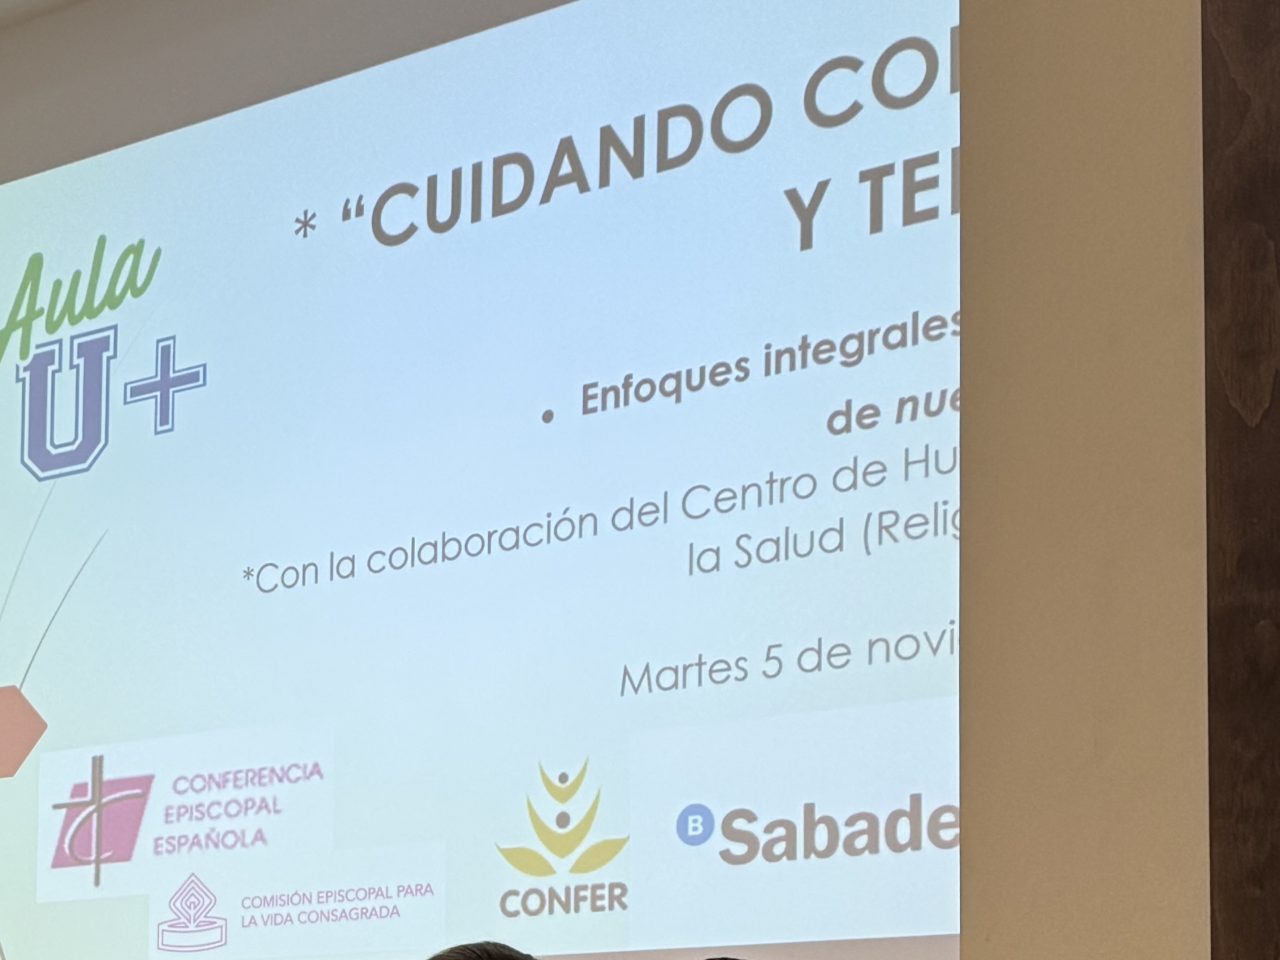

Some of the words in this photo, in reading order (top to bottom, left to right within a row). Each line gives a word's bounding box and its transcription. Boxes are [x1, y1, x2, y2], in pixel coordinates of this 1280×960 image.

[783, 178, 832, 252] Y
[581, 355, 751, 415] Enfoques
[827, 399, 881, 436] de
[329, 551, 355, 581] la
[366, 506, 598, 574] colaboración
[611, 491, 668, 532] del
[681, 471, 818, 519] Centro
[832, 455, 887, 493] de
[689, 542, 721, 576] la
[734, 517, 844, 568] Salud
[620, 653, 749, 697] Martes
[762, 644, 783, 679] 5
[797, 637, 852, 673] de
[172, 761, 324, 796] CONFERENCIA
[164, 796, 282, 824] EPISCOPAL
[153, 827, 268, 856] ESPAÑOLA
[241, 890, 312, 911] COMISIÓN
[317, 885, 392, 905] EPISCOPAL
[396, 882, 434, 900] PARA
[499, 882, 629, 918] CONFER
[241, 914, 258, 928] LA
[262, 911, 294, 927] VIDA
[297, 905, 401, 925] CONSAGRADA
